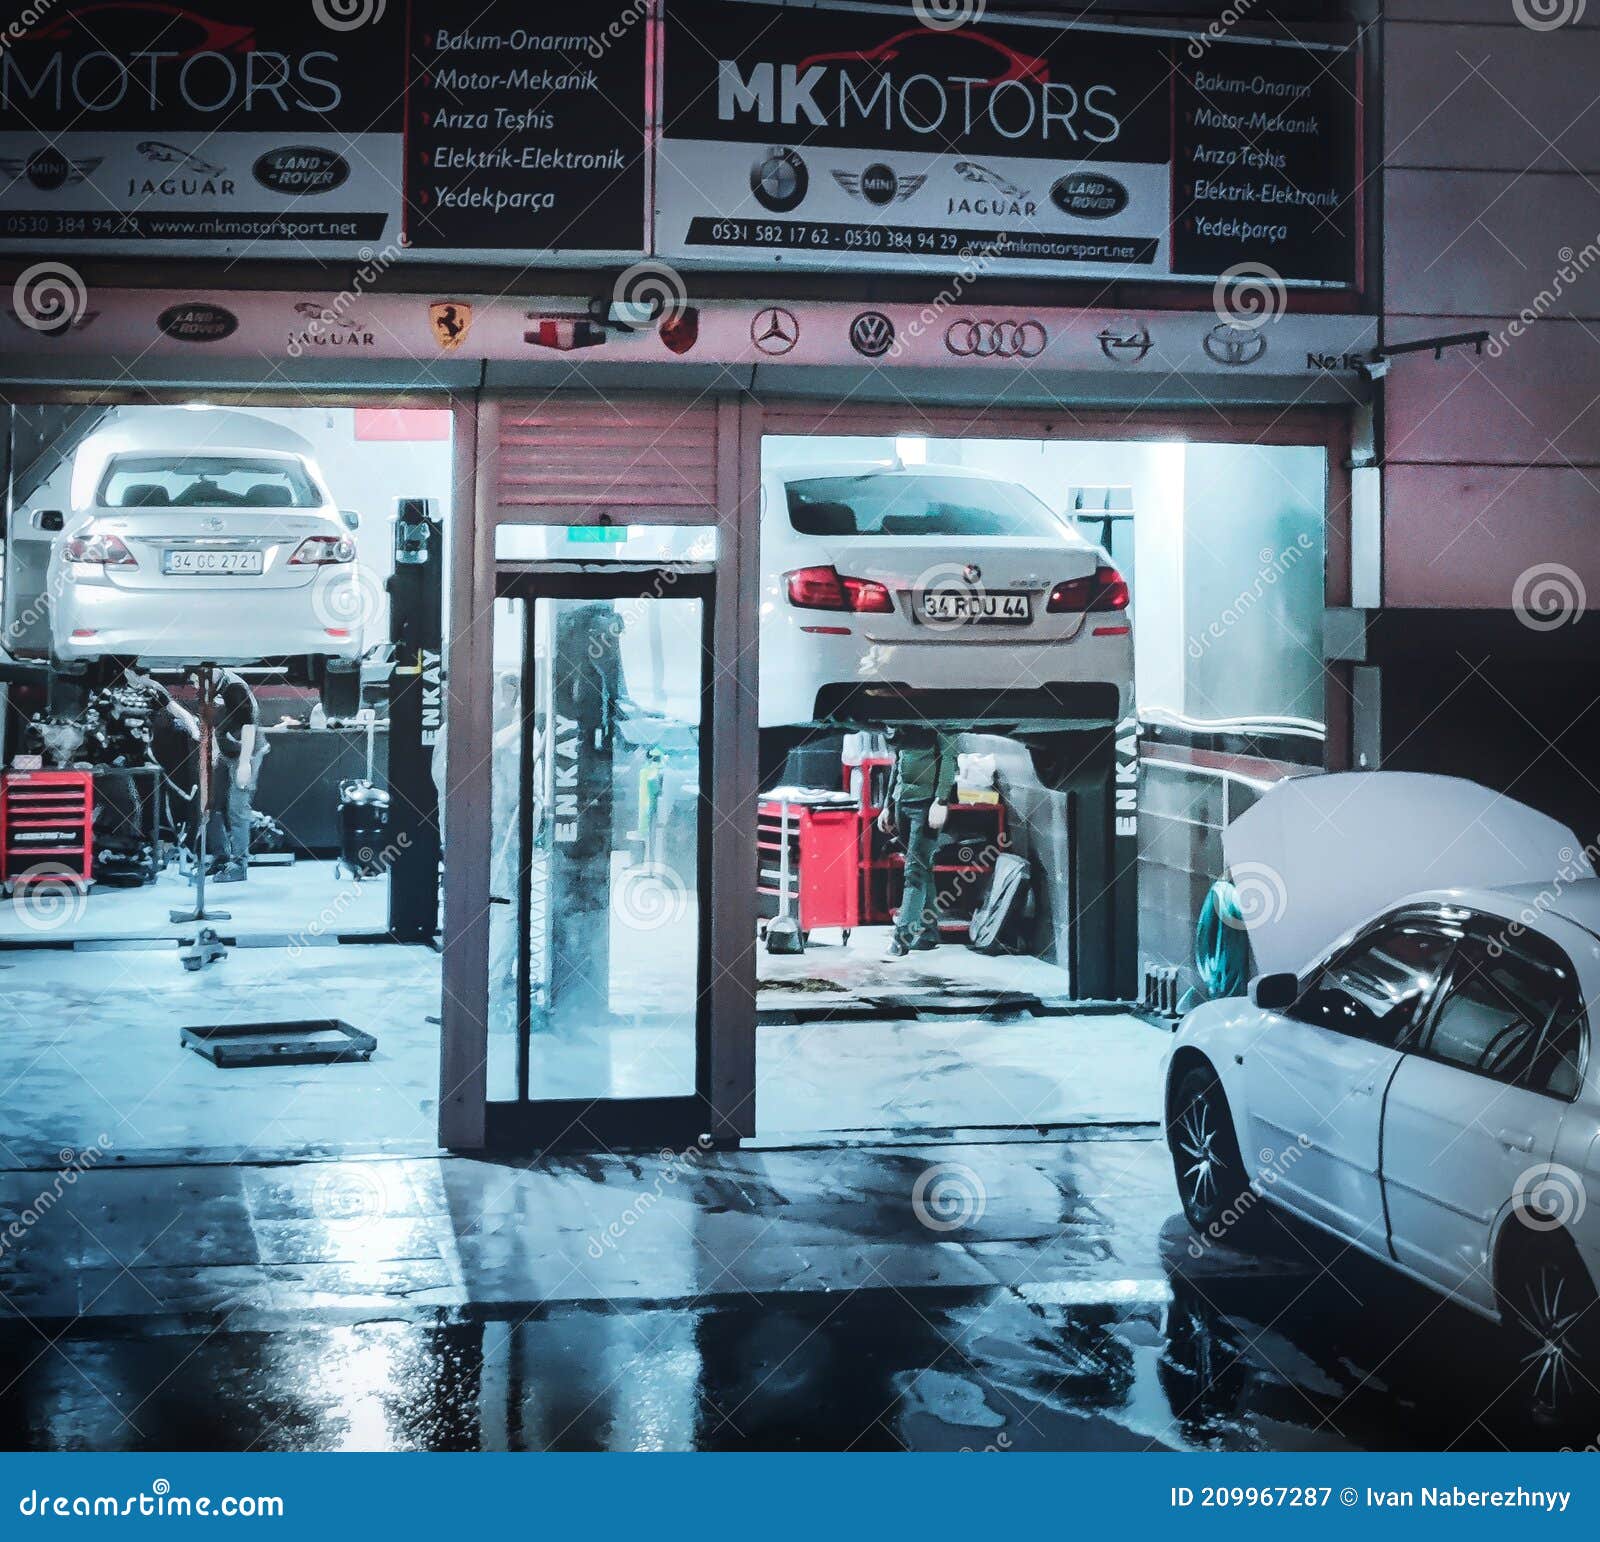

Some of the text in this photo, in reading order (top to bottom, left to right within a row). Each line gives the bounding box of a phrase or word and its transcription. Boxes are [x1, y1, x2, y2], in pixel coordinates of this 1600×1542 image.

[434, 29, 590, 52] Bakım-Onarım
[1, 50, 343, 113] MOTORS
[433, 68, 599, 92] Motor-Mekanik
[432, 107, 554, 132] Arıza Teşhis
[1193, 107, 1320, 135] Motor-Mekanik
[274, 156, 321, 170] LAND
[433, 146, 626, 171] Elektrik-Elektronik
[1192, 144, 1288, 169] Arıza Teşhis
[31, 162, 65, 175] MINI
[277, 171, 335, 185] ROVER
[127, 178, 236, 198] JAGUAR
[863, 178, 894, 191] MINI
[1067, 182, 1106, 195] LAND
[1194, 179, 1341, 207] Elektrik-Elektronik
[433, 186, 555, 214] Yedekparça
[947, 197, 1038, 217] JAGUAR
[1070, 196, 1117, 209] ROVER
[7, 216, 358, 238] 0530 384 94 29 www.mkmotorsport.net
[711, 224, 748, 241] 0531
[755, 225, 783, 243] 582
[789, 227, 805, 243] 17
[811, 227, 830, 245] 62
[845, 229, 881, 246] 0530
[886, 231, 913, 248] 384
[917, 232, 935, 249] 94
[940, 234, 958, 250] 29
[1194, 215, 1288, 246] Yedekparça
[177, 311, 215, 322] LAND
[179, 322, 225, 334] ROVER
[287, 333, 375, 346] JAGUAR
[173, 556, 192, 569] 34
[220, 556, 258, 569] 2721
[926, 597, 949, 616] 34
[1002, 597, 1025, 617] 44
[421, 648, 441, 746] ENKAY
[554, 714, 580, 844] ENKAY
